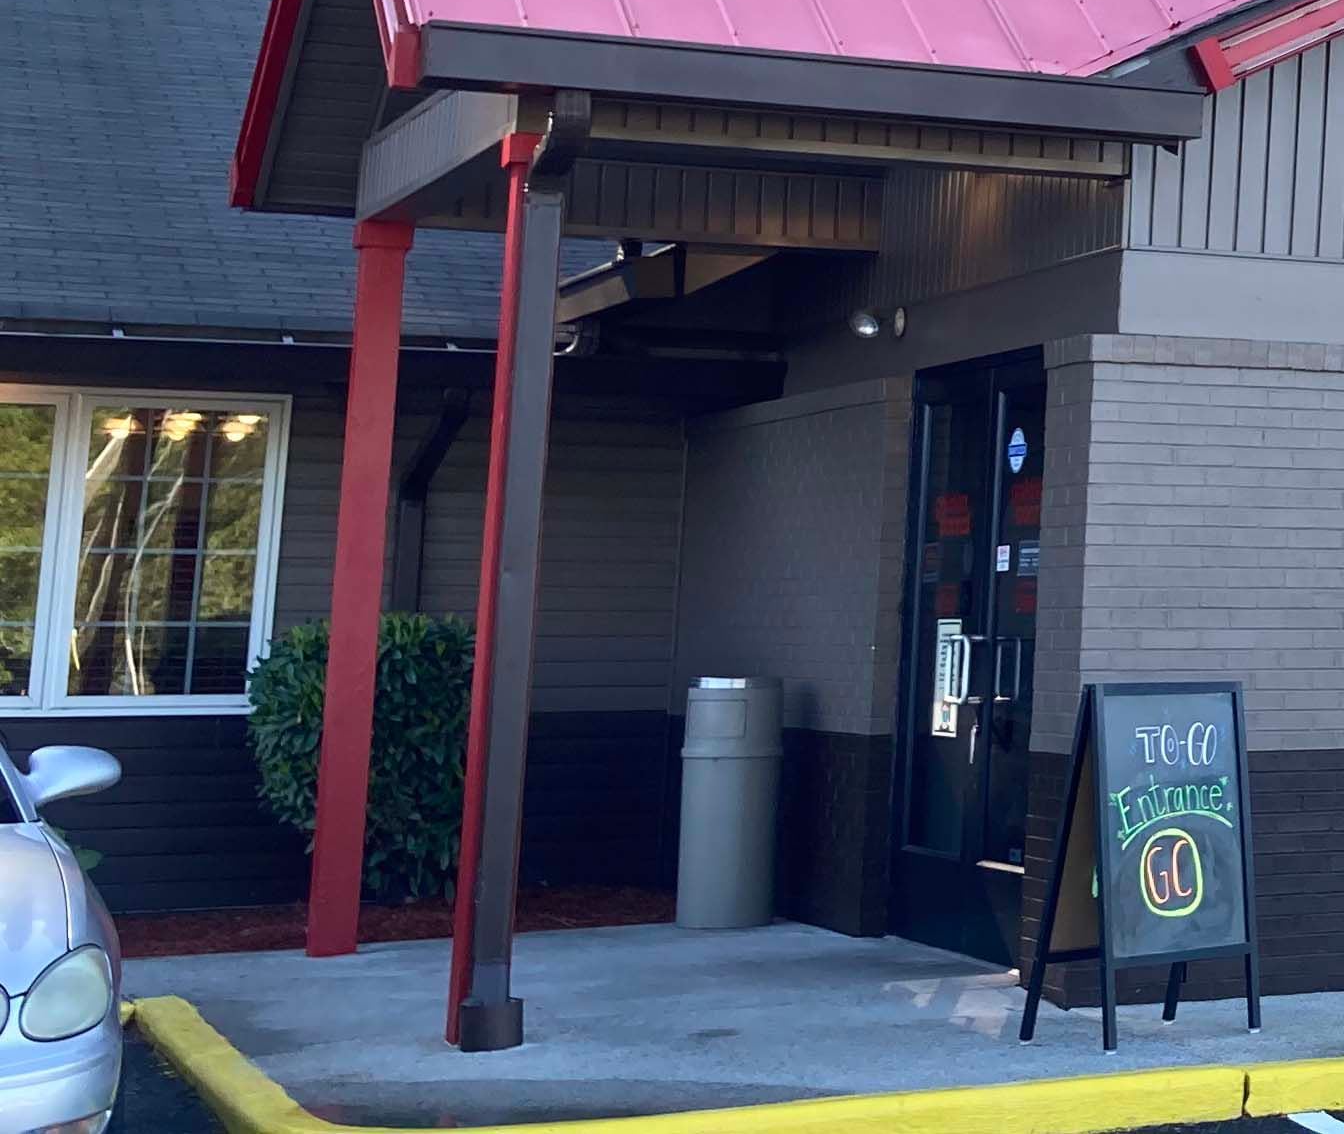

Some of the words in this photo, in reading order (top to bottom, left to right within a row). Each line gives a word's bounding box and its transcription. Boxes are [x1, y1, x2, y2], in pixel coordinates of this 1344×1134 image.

[1135, 721, 1218, 766] TO-GO
[1116, 774, 1224, 835] Entrance
[1146, 839, 1193, 905] GC
